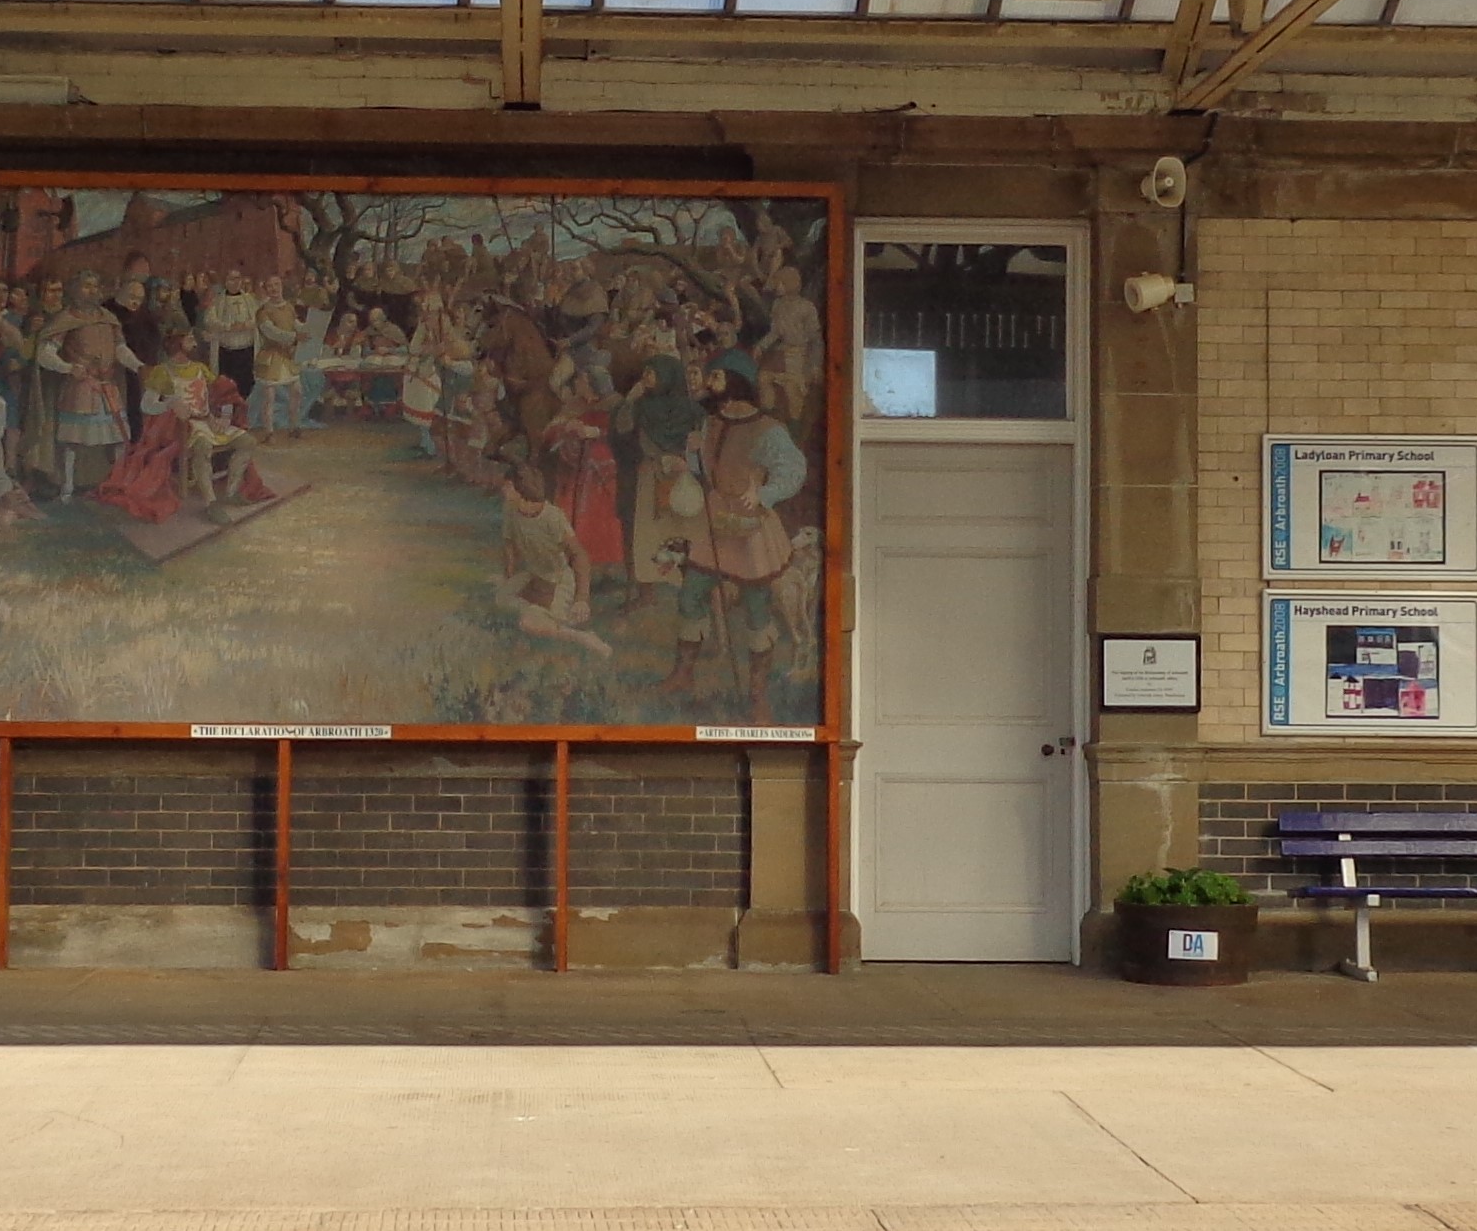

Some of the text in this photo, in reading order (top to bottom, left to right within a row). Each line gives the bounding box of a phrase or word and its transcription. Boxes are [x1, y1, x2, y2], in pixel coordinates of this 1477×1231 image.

[1294, 450, 1435, 462] Ladyloan Primary School
[1294, 605, 1438, 618] Hayshead Primary School
[199, 726, 219, 736] THE
[221, 726, 290, 737] DECLARATION
[293, 727, 305, 737] OF
[309, 727, 362, 737] ARBROATH
[1183, 933, 1204, 953] DA
